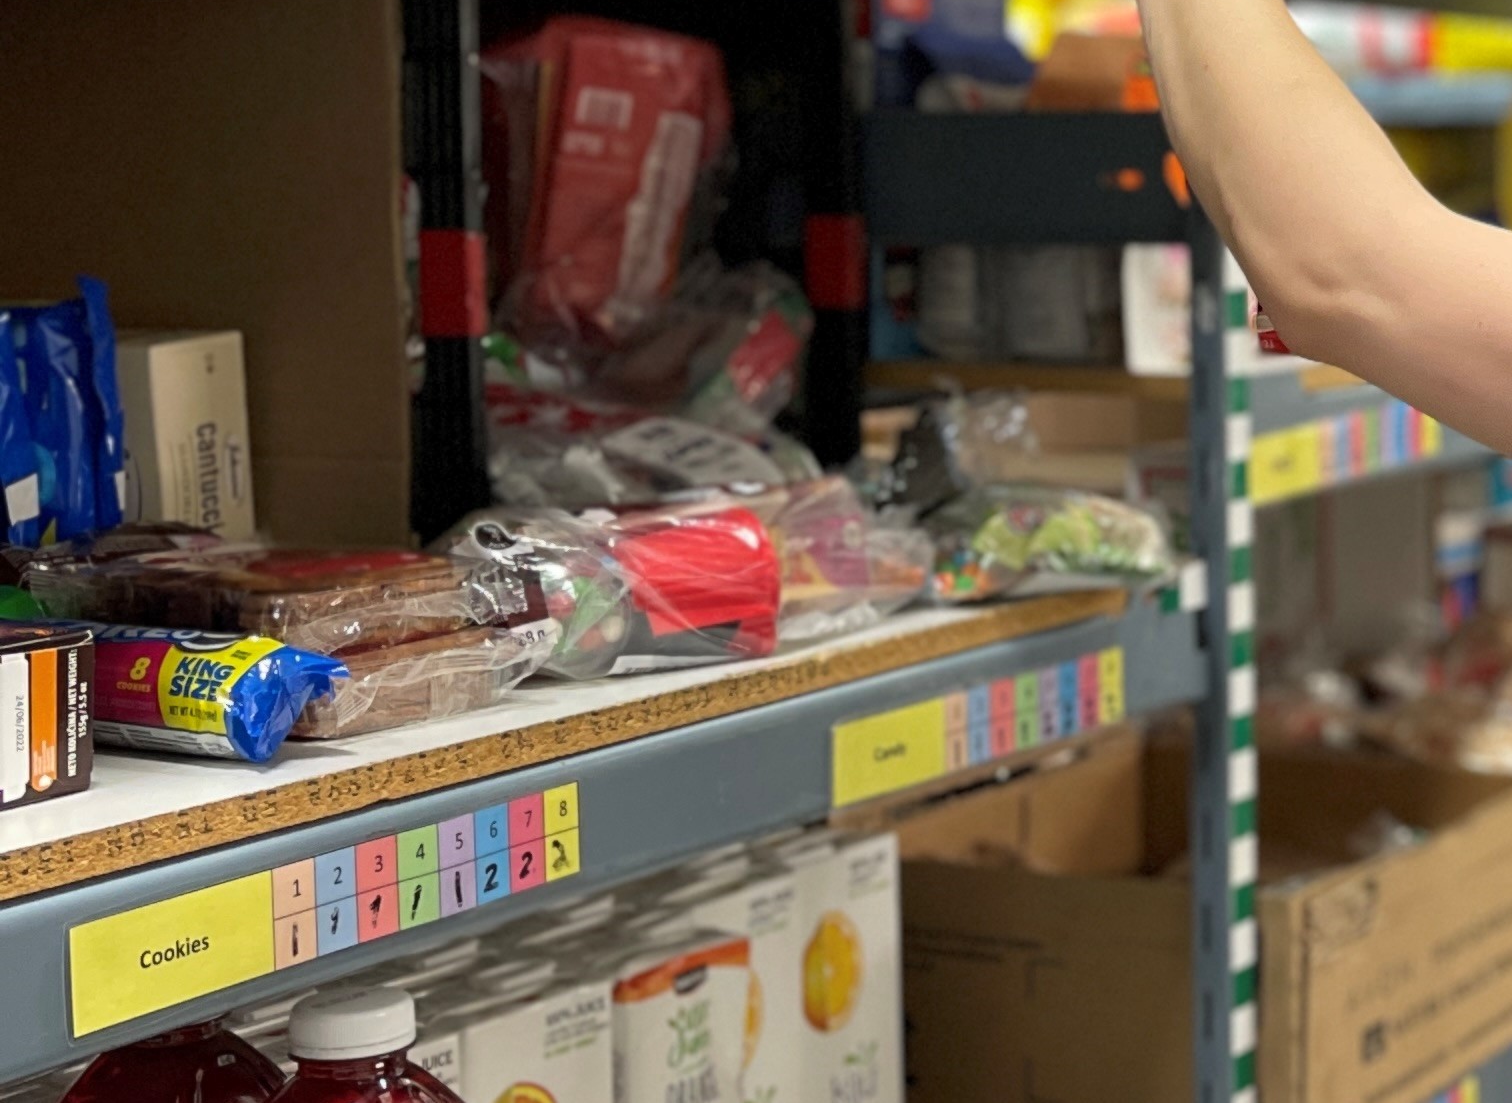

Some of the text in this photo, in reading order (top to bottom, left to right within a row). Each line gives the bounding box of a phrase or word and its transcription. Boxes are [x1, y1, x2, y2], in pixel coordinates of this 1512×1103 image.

[129, 657, 151, 681] 8
[174, 656, 236, 681] KING
[67, 688, 77, 705] NET
[168, 675, 223, 702] SIZE
[67, 753, 77, 777] NETO
[292, 800, 568, 897] 1 2 3 4 5 6 7 8
[483, 863, 499, 893] 2
[519, 851, 533, 879] 2
[140, 936, 210, 969] Cookies
